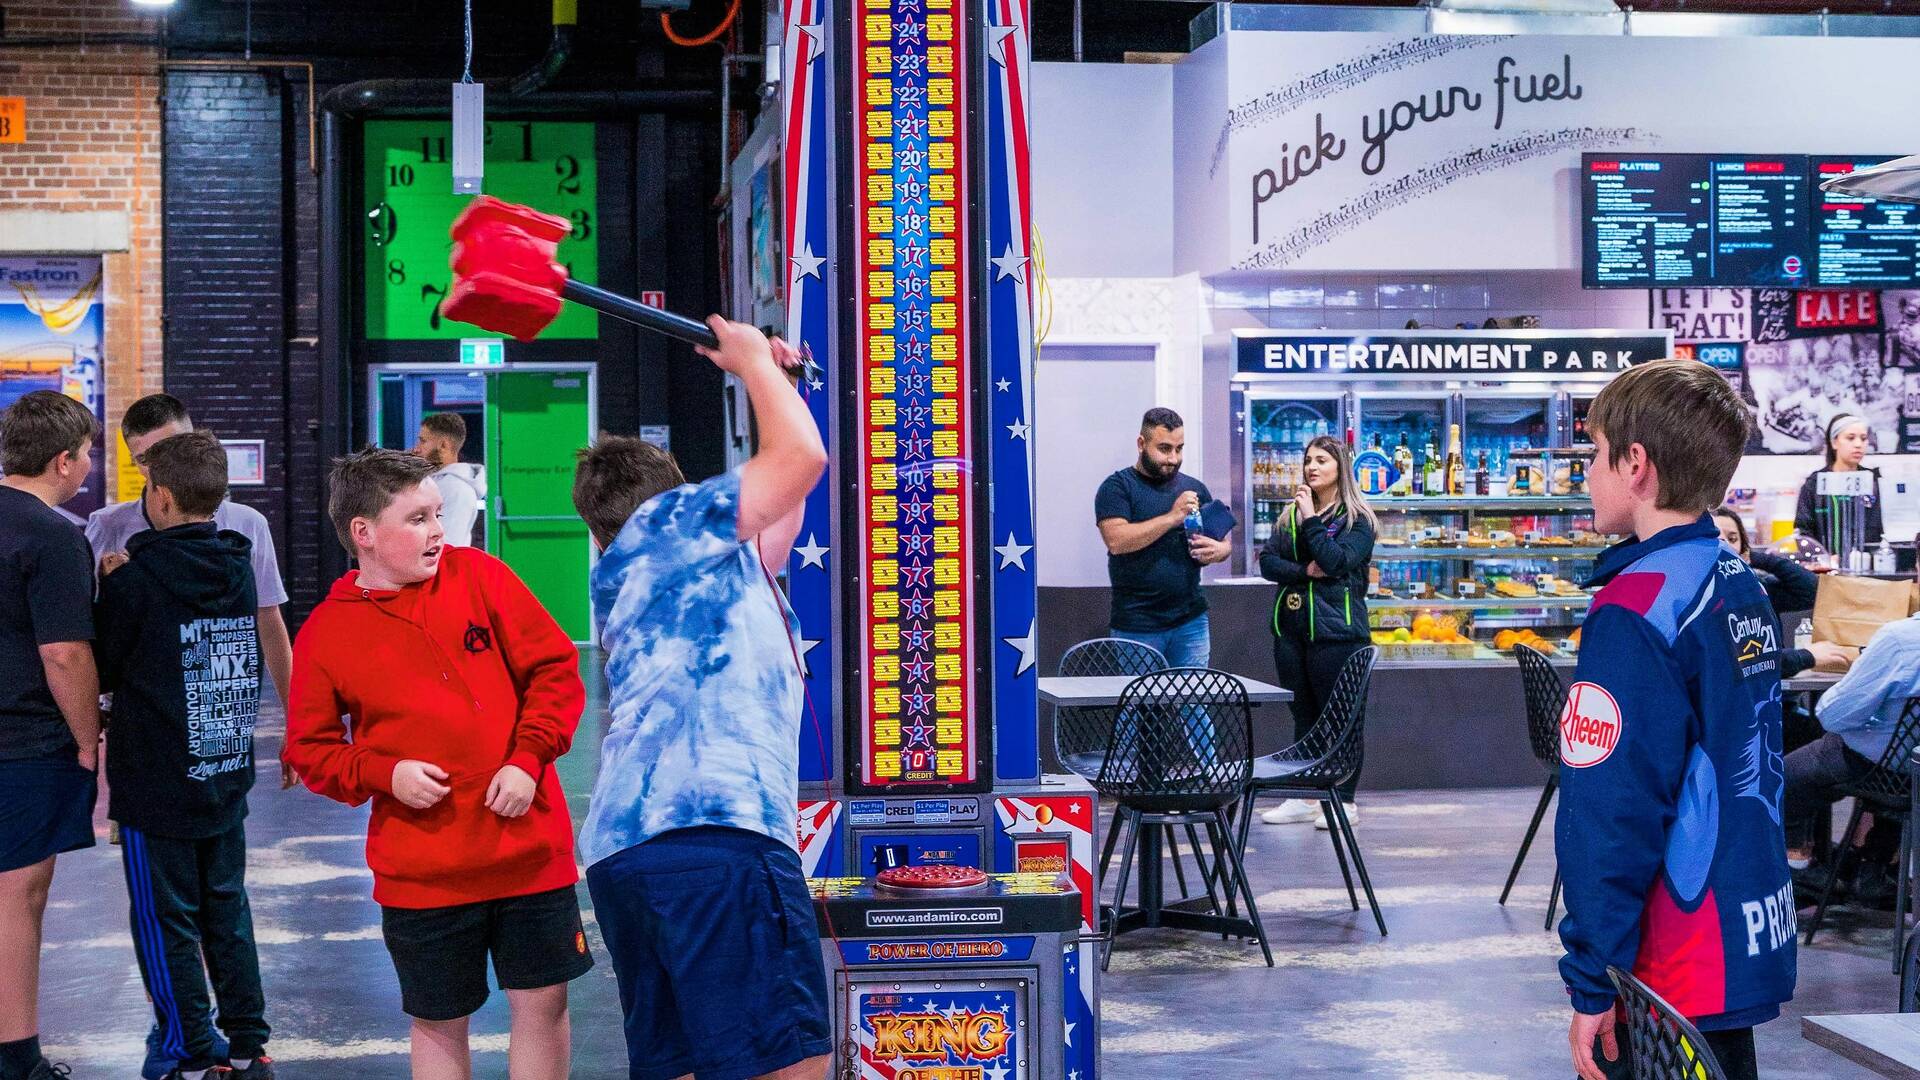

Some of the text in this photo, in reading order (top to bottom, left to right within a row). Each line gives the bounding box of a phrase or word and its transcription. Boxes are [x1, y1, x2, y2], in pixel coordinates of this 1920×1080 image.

[900, 26, 919, 38] 24
[900, 57, 919, 69] 23
[901, 89, 920, 102] 22
[901, 120, 919, 134] 21
[422, 137, 446, 164] 11
[517, 124, 539, 163] 1
[1253, 54, 1583, 245] pick your fuel
[900, 152, 921, 166] 20
[1620, 163, 1660, 171] PLATTERS
[388, 165, 414, 187] 10
[556, 155, 580, 195] 2
[901, 184, 920, 198] 19
[571, 209, 590, 240] 3
[903, 216, 921, 230] 18
[1820, 234, 1845, 242] PASTA
[903, 248, 922, 262] 17
[0, 266, 79, 281] Fastron
[388, 259, 406, 285] 8
[903, 279, 922, 293] 16
[422, 284, 447, 330] 7
[1801, 293, 1872, 323] CAFE
[904, 311, 922, 325] 15
[1662, 313, 1745, 339] EAT!
[905, 343, 923, 357] 14
[1264, 343, 1634, 370] ENTERTAINMENT PARK
[1700, 347, 1738, 364] OPEN
[1746, 346, 1784, 365] OPEN
[905, 375, 923, 389] 13
[905, 407, 923, 421] 12
[907, 440, 923, 453] 11
[906, 472, 924, 485] 10
[911, 503, 921, 518] 9
[911, 535, 921, 550] 8
[911, 568, 922, 582] 7
[912, 600, 921, 614] 6
[203, 615, 256, 632] TURKEY
[1728, 613, 1761, 643] Century
[211, 631, 247, 642] COMPASS
[913, 632, 922, 646] 5
[1761, 625, 1778, 654] 21
[209, 641, 249, 656] LOUEE
[247, 630, 258, 667] CORNER
[211, 654, 248, 679] MX
[912, 664, 922, 678] 4
[198, 676, 259, 693] THUMPERS
[913, 695, 923, 710] 3
[185, 682, 201, 757] BOUNDARY
[1561, 684, 1614, 752] Rheem
[914, 727, 924, 741] 2
[904, 752, 935, 770] 1 0 1
[906, 772, 934, 780] CREDIT
[885, 806, 915, 816] CRED
[950, 805, 977, 814] PLAY
[872, 911, 998, 924] www.andamiro.com
[868, 941, 1004, 960] POWER OF HERO
[875, 1015, 1004, 1056] KING
